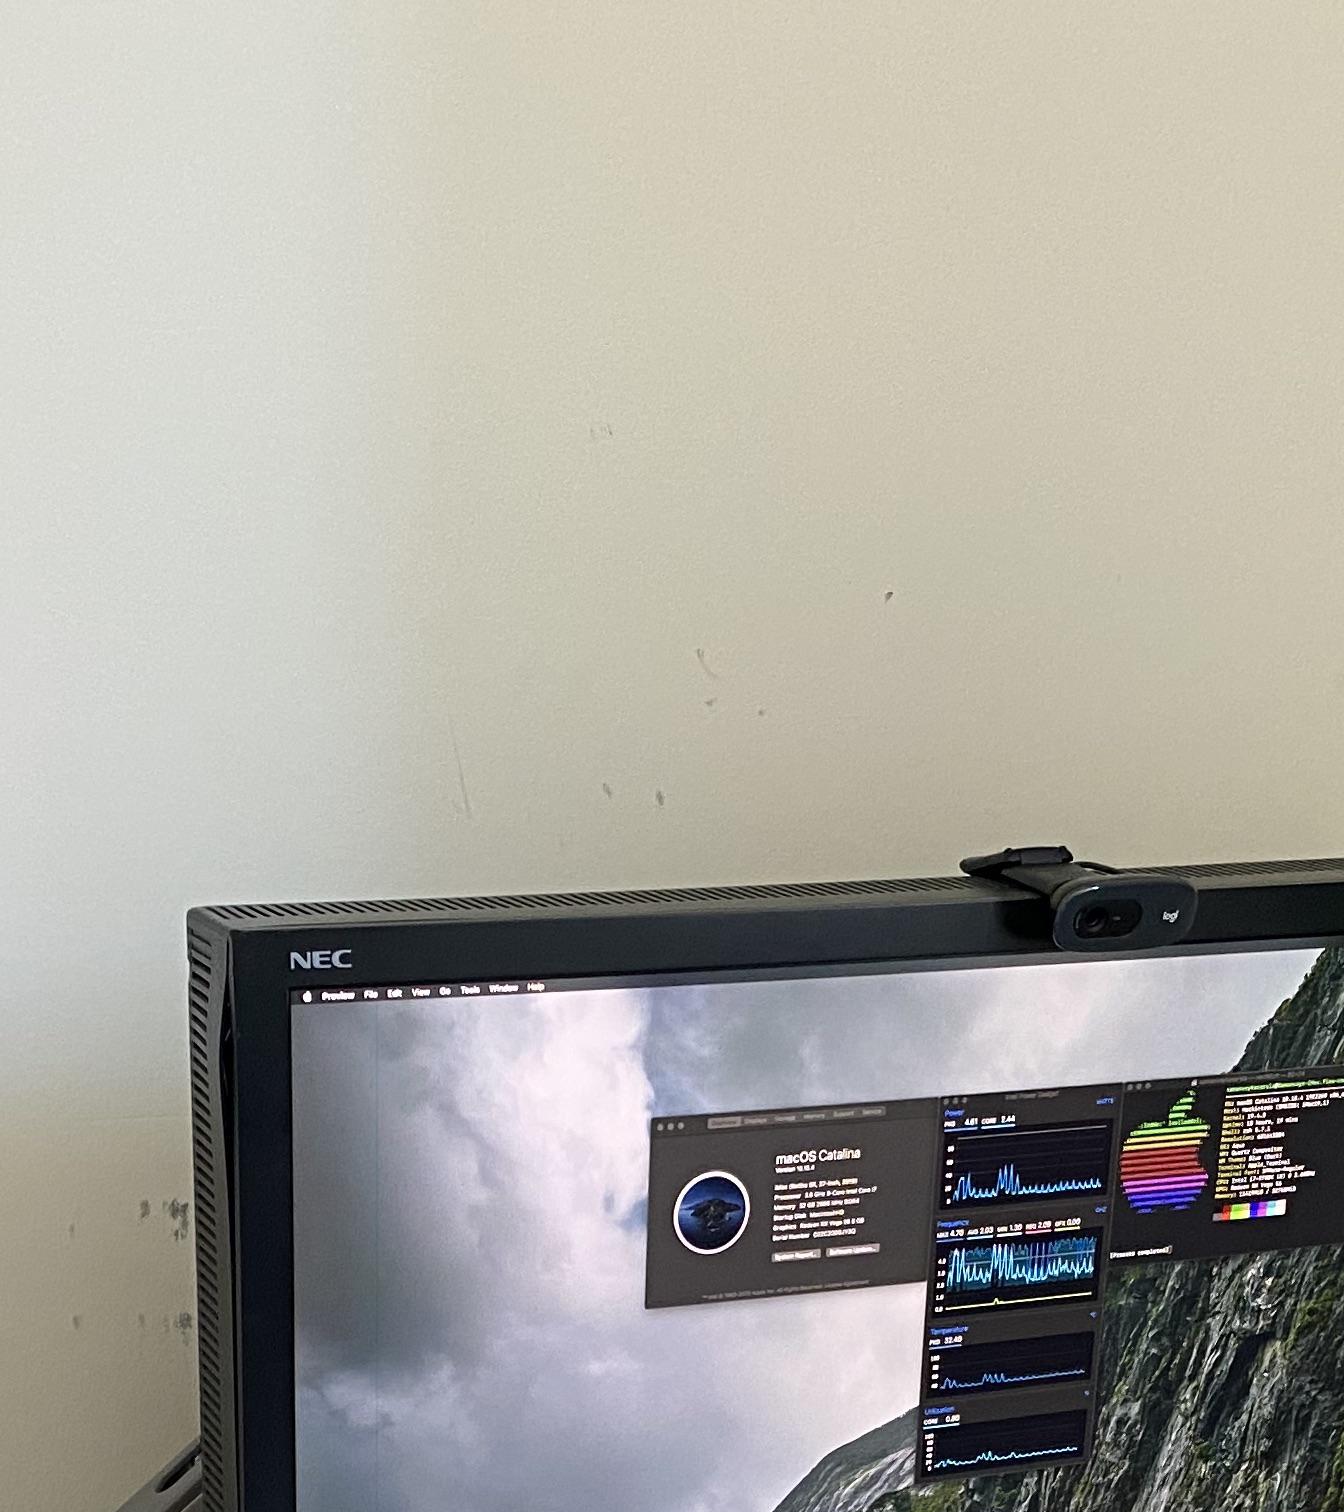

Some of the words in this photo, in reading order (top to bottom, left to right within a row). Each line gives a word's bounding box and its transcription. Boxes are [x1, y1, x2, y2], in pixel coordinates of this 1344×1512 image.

[1163, 910, 1179, 922] logi
[290, 949, 352, 969] NEC
[322, 991, 355, 1001] Preview
[364, 990, 378, 998] File
[387, 989, 403, 998] Edit
[412, 988, 430, 997] View
[439, 987, 451, 995] Go
[460, 986, 480, 994] Tools
[489, 984, 518, 993] Window
[527, 982, 545, 992] Help
[944, 1109, 964, 1117] Power
[776, 1151, 816, 1165] macOS
[819, 1148, 861, 1160] Catalina
